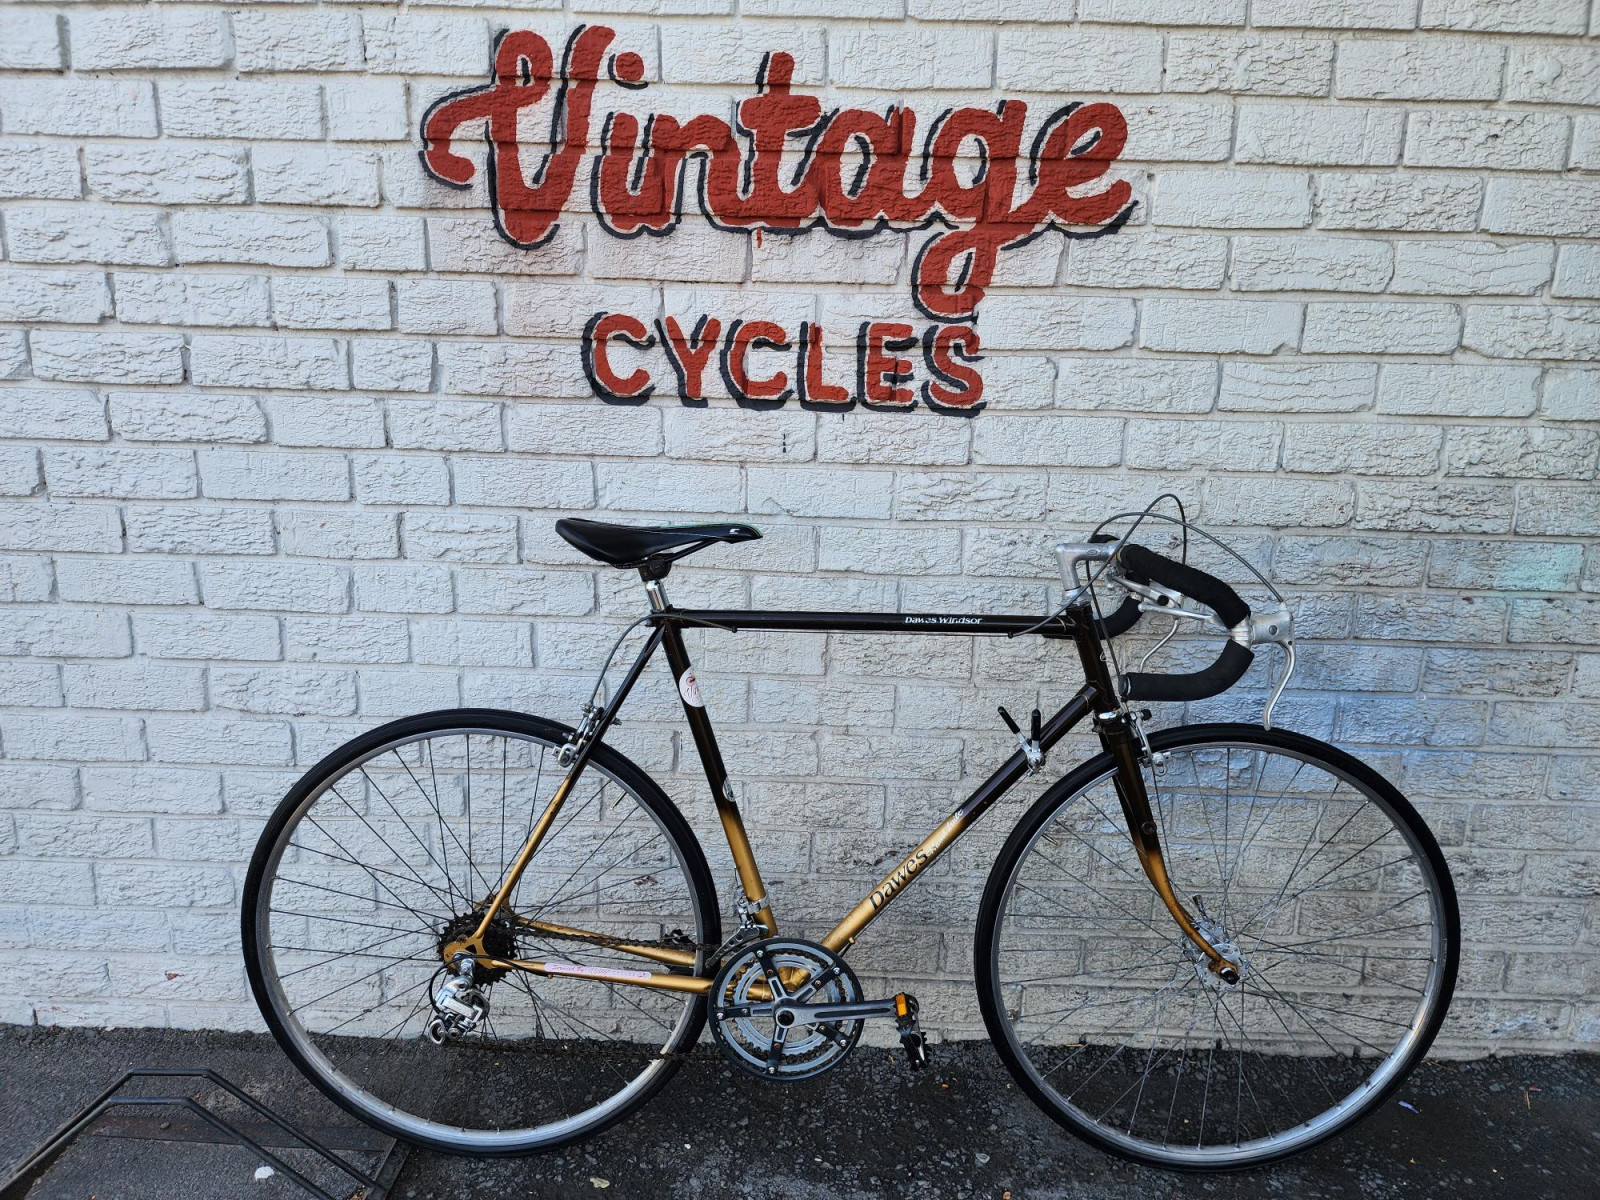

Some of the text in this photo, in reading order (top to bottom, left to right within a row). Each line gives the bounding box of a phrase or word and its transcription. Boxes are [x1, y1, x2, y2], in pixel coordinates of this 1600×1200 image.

[420, 24, 1138, 322] Vintage
[582, 310, 987, 416] CYCLES
[904, 616, 982, 625] Dawes Windsor
[869, 848, 928, 910] Dawes
